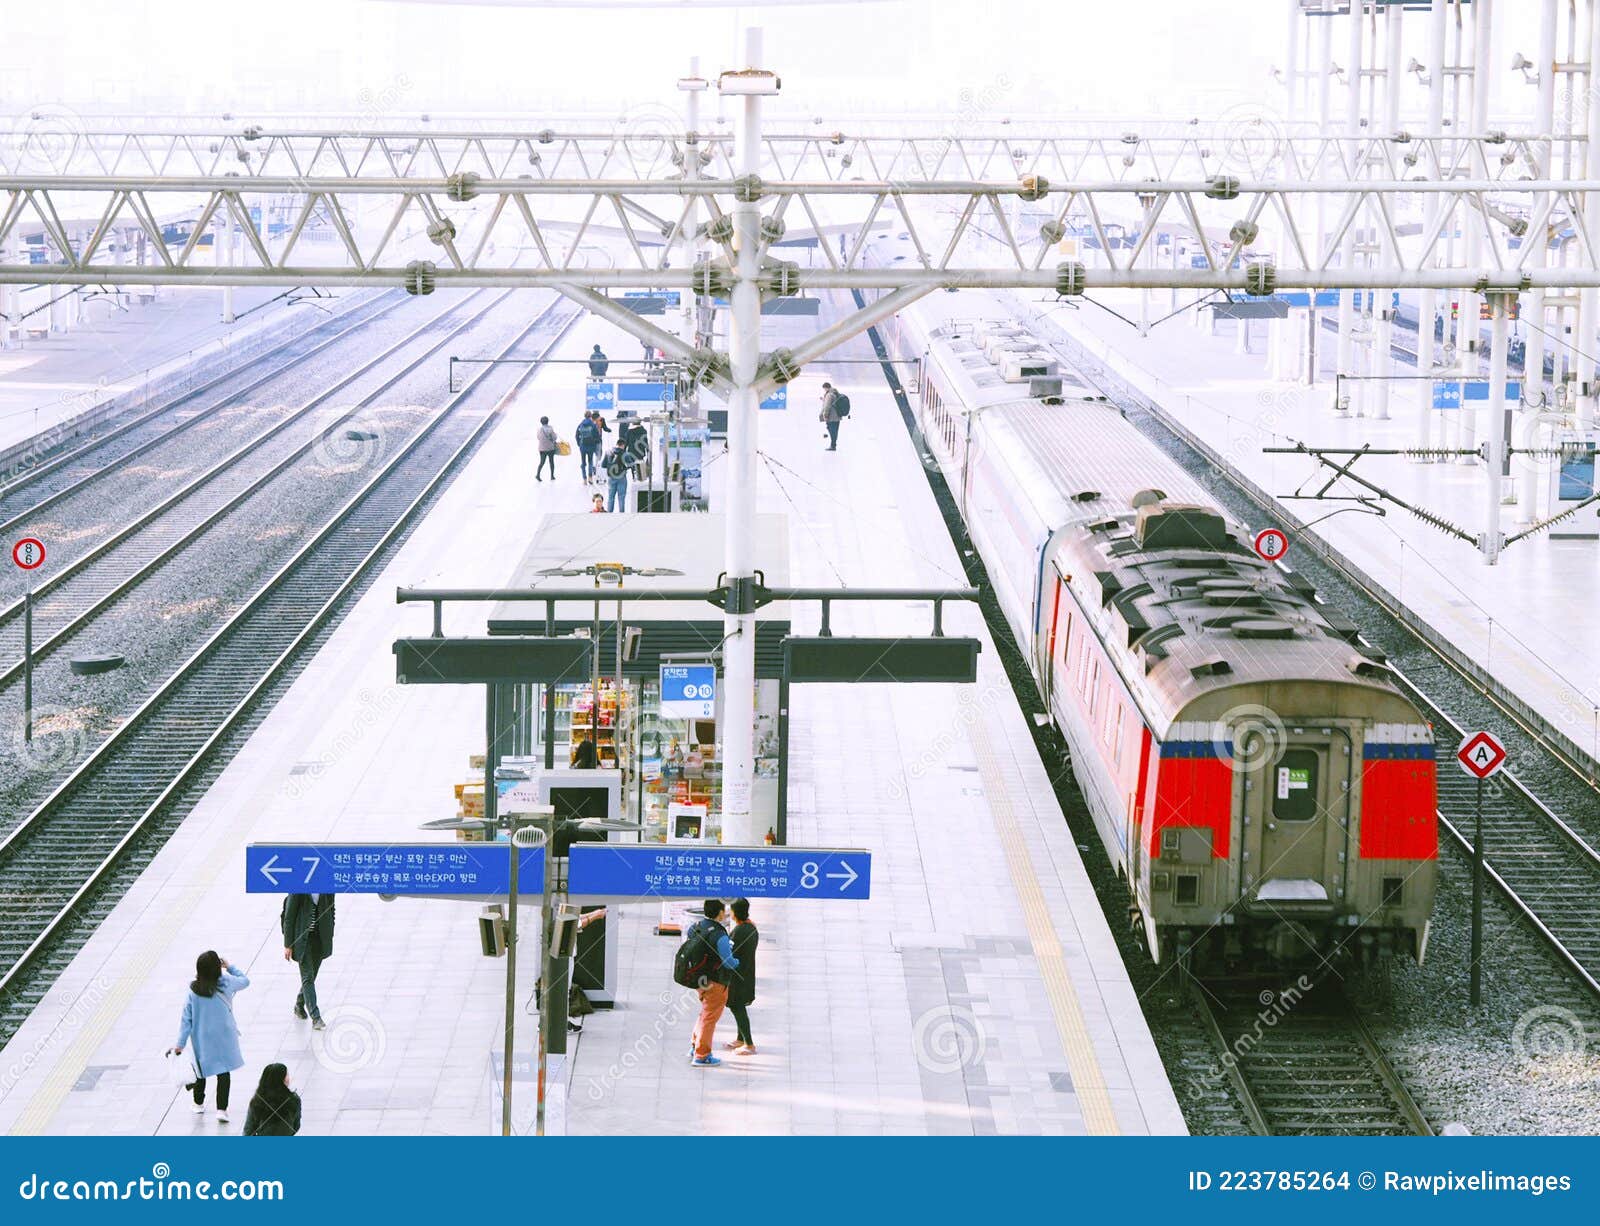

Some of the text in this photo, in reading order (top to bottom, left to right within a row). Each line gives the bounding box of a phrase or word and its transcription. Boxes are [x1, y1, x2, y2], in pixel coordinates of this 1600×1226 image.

[1268, 535, 1275, 545] 8
[25, 543, 33, 553] 8
[1268, 545, 1275, 555] 6
[25, 554, 33, 564] 6
[700, 686, 711, 696] 10
[1475, 746, 1489, 762] A
[302, 856, 321, 884] 7
[800, 861, 819, 889] 8
